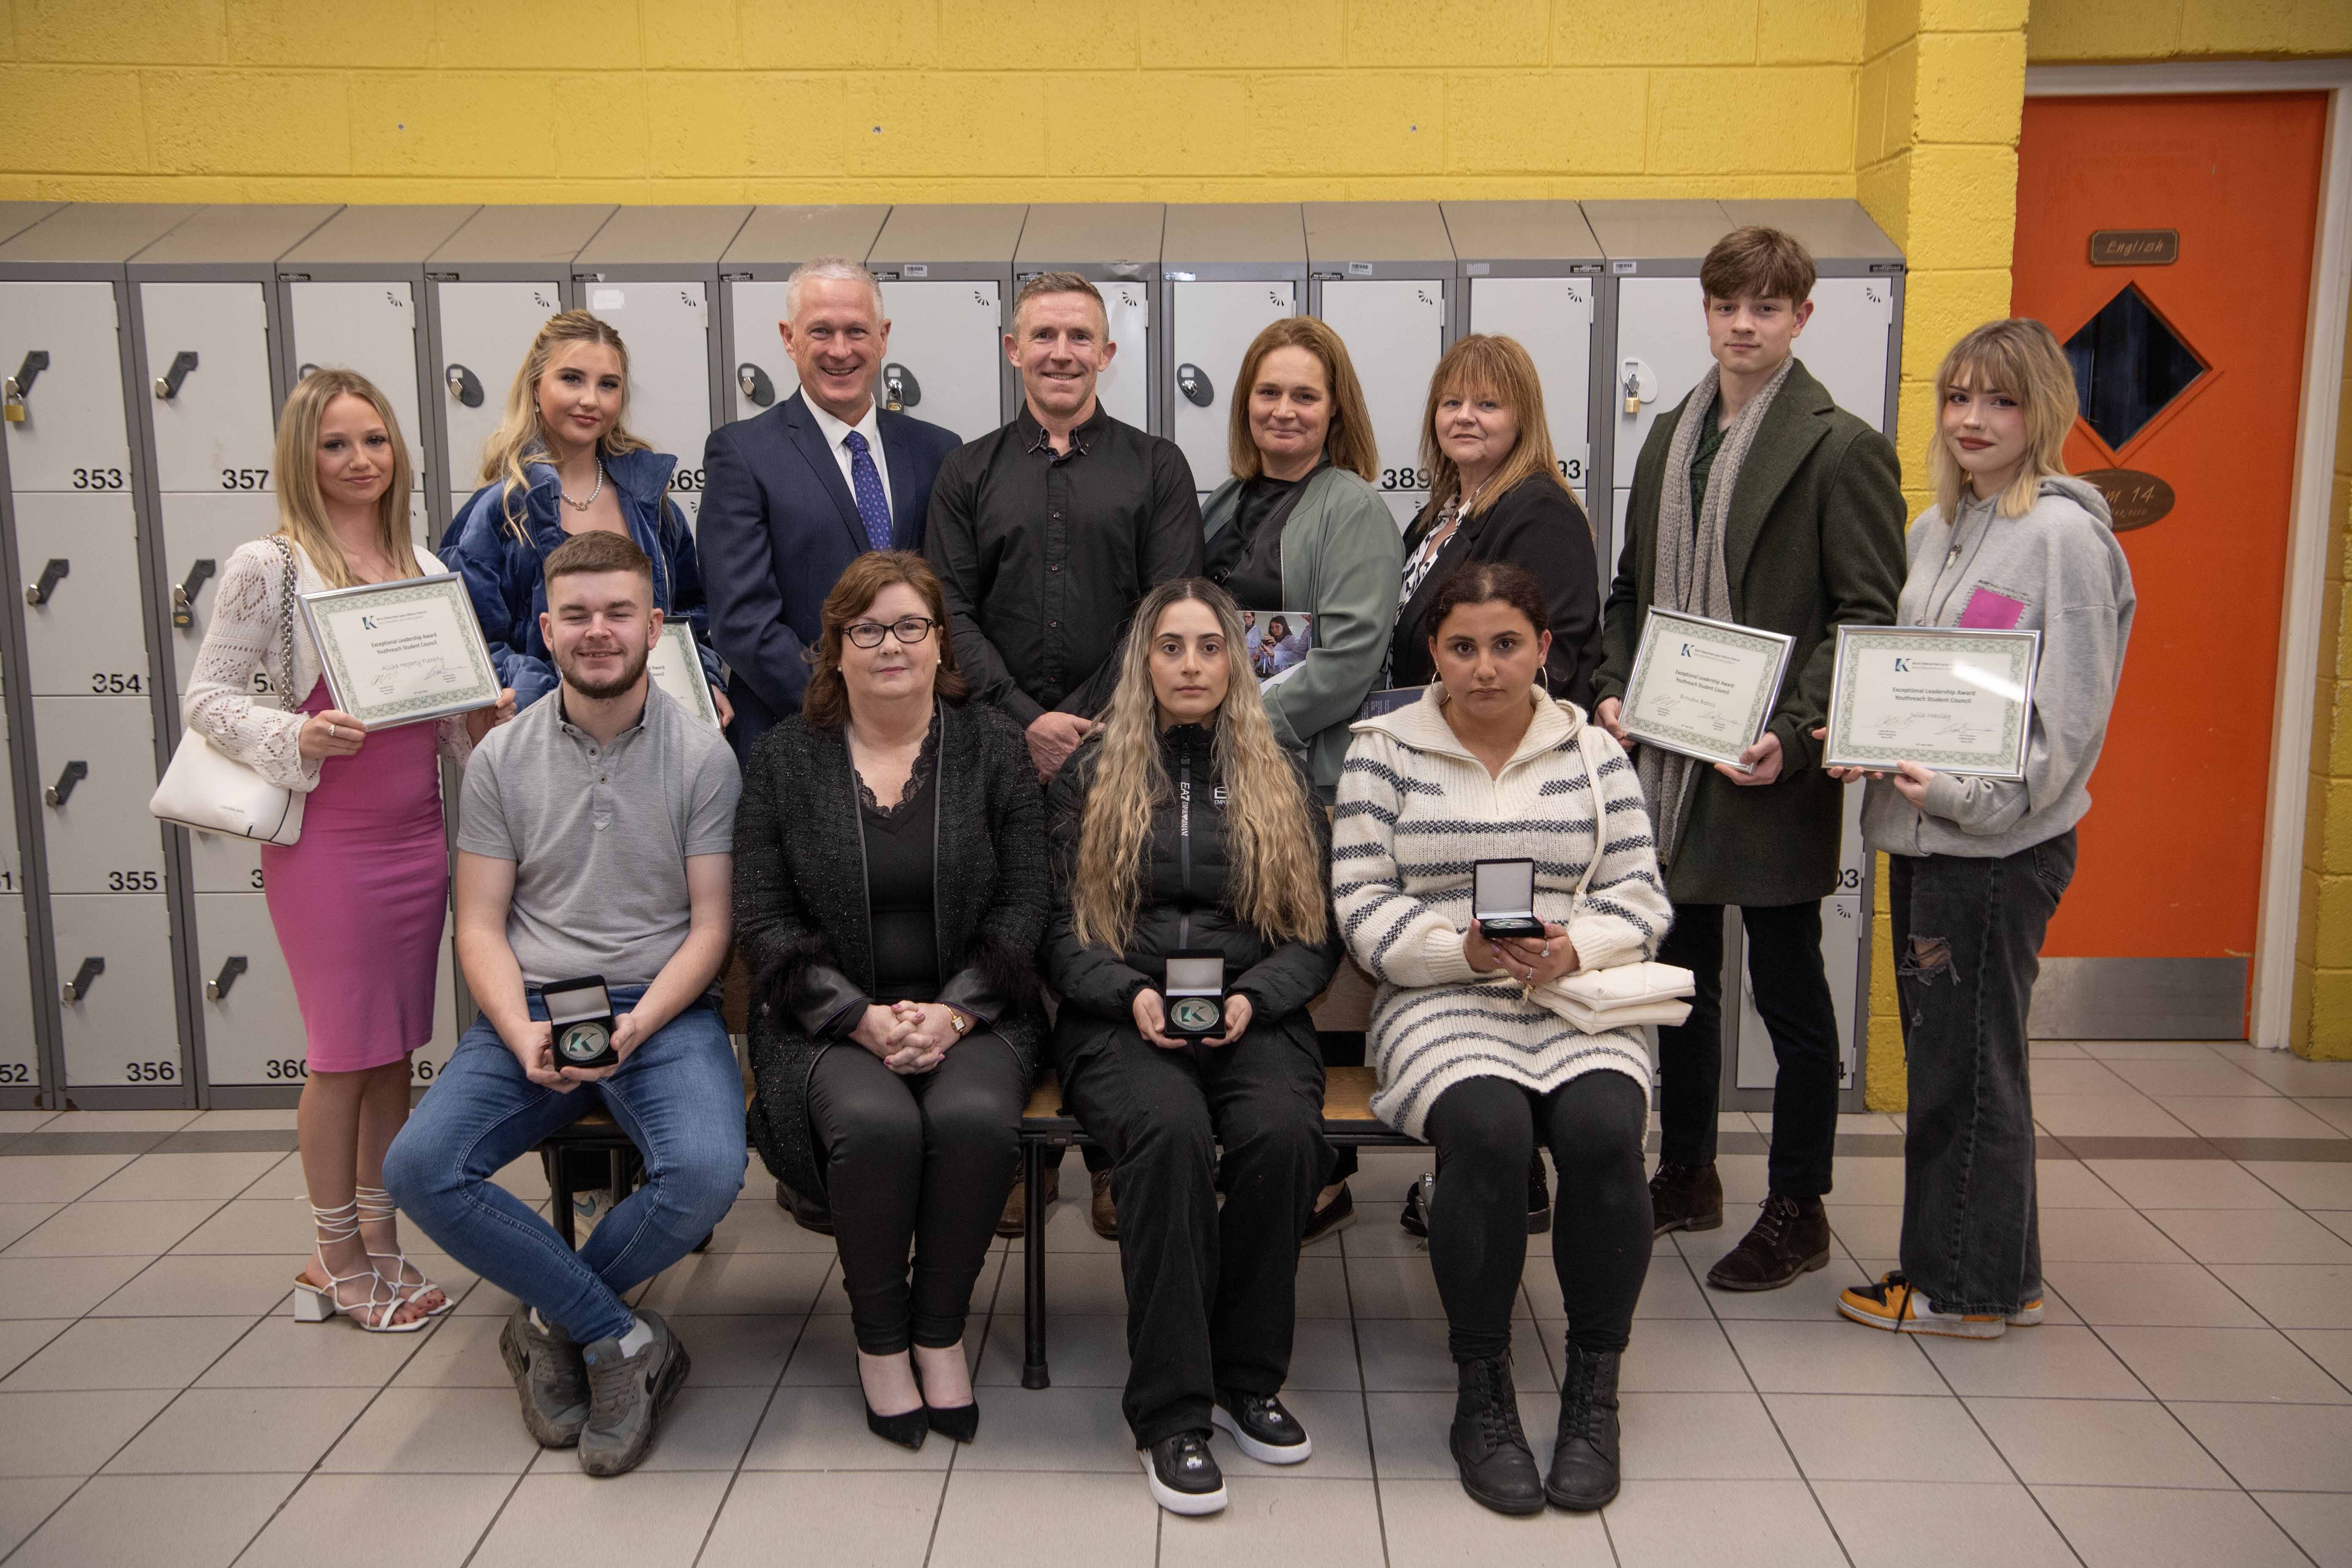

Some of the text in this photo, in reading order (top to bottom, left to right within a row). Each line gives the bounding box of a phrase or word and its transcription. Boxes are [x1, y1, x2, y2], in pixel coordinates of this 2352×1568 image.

[2106, 239, 2164, 257] English
[73, 468, 123, 489] 353
[222, 469, 269, 489] 357
[2132, 485, 2155, 504] 14
[371, 639, 397, 648] Exceptional
[398, 635, 422, 643] Leadership
[1895, 658, 1912, 672] K
[93, 673, 142, 694] 354
[1675, 670, 1698, 679] Exceptional
[1698, 676, 1720, 685] Leadership
[1676, 678, 1698, 687] Youthreach
[1181, 782, 1190, 801] EA7
[109, 871, 158, 891] 355
[126, 1061, 175, 1082] 356
